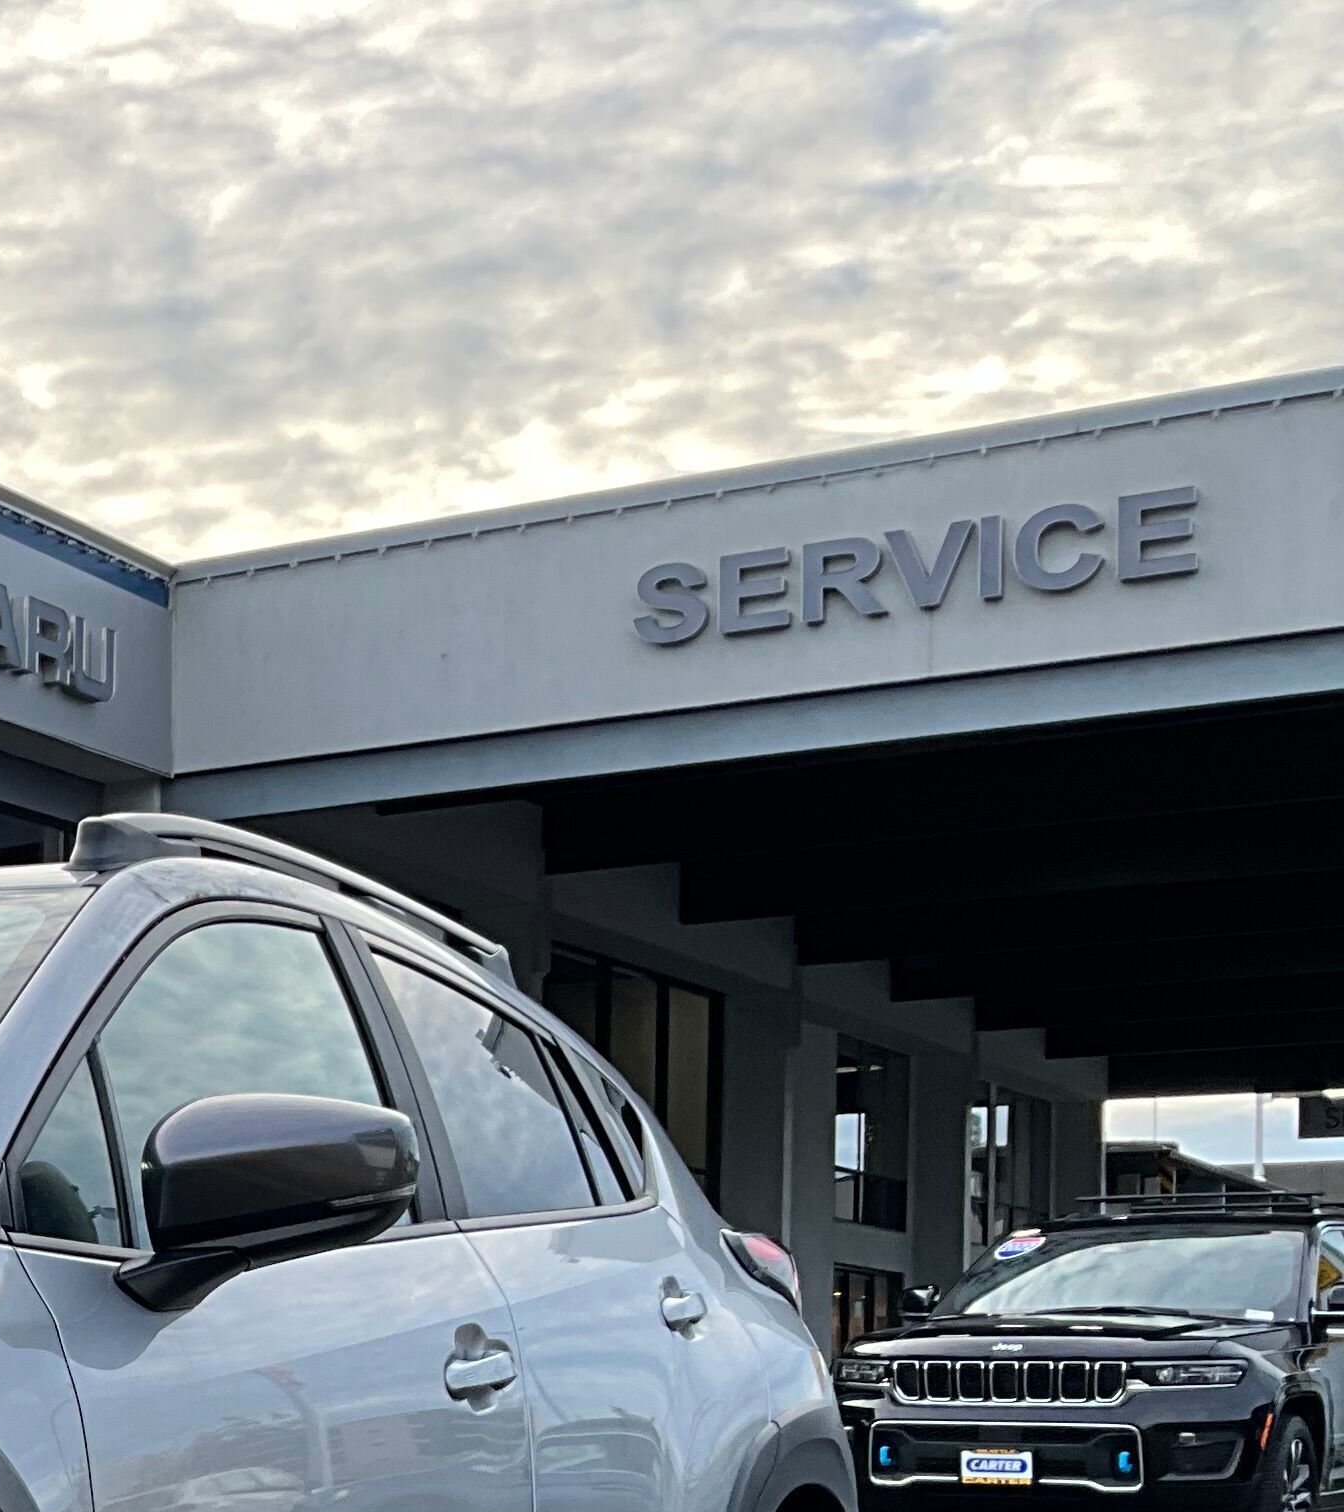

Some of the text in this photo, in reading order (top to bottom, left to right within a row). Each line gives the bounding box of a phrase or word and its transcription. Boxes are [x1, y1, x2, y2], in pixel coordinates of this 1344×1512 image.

[633, 485, 1201, 647] SERVICE
[992, 1343, 1023, 1351] Jeep
[971, 1459, 1023, 1471] CARTER
